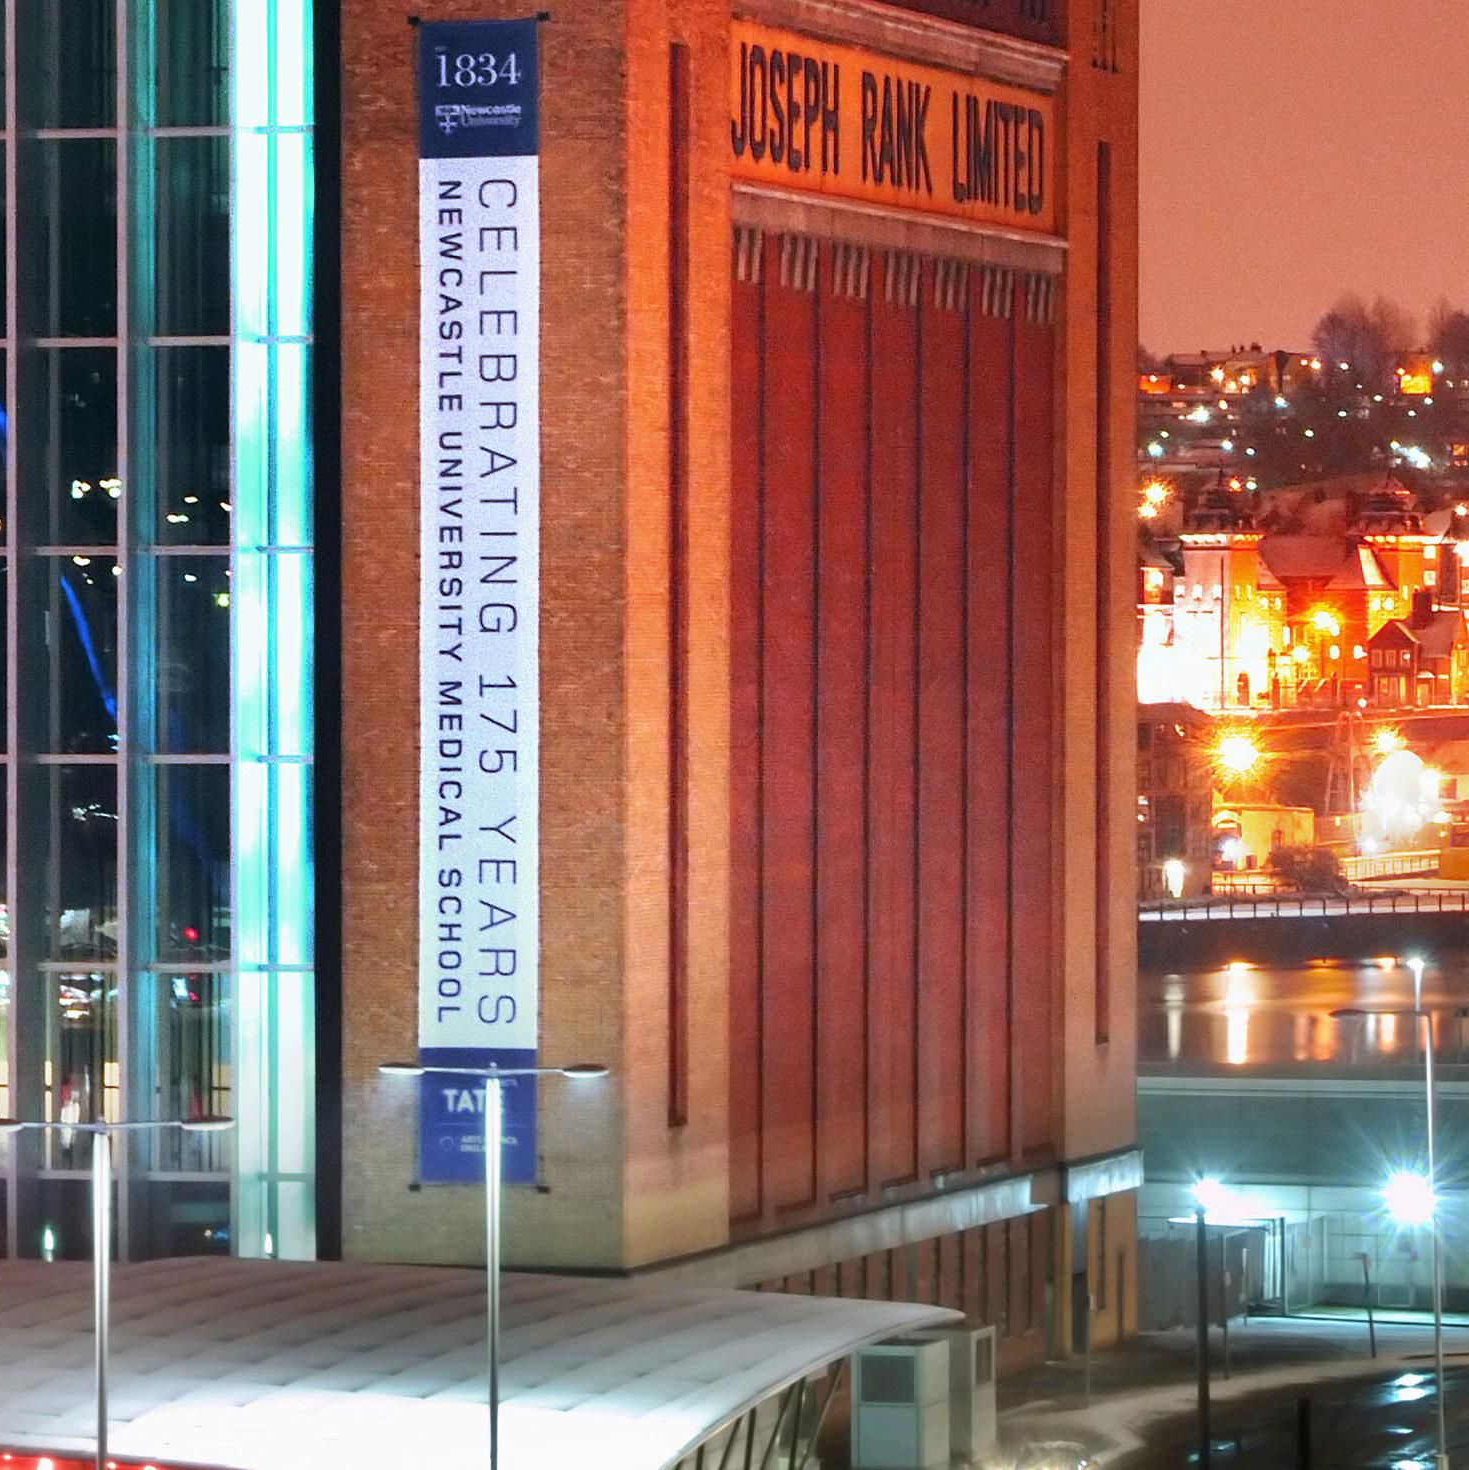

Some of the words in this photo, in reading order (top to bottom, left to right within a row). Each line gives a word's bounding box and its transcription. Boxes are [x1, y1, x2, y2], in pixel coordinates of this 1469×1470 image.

[437, 53, 521, 87] 1834
[731, 42, 840, 176] JOSEPH
[862, 71, 932, 195] RANK
[953, 91, 1045, 215] LIMITED
[438, 180, 463, 412] NEWCASTLE
[479, 179, 518, 633] CELEBRATING
[438, 431, 463, 662] UNIVERSITY
[438, 681, 462, 850] MEDICAL
[479, 674, 517, 773] 175
[438, 868, 462, 1023] SCHOOL
[479, 815, 517, 1023] YEARS
[442, 1089, 505, 1113] TAT
